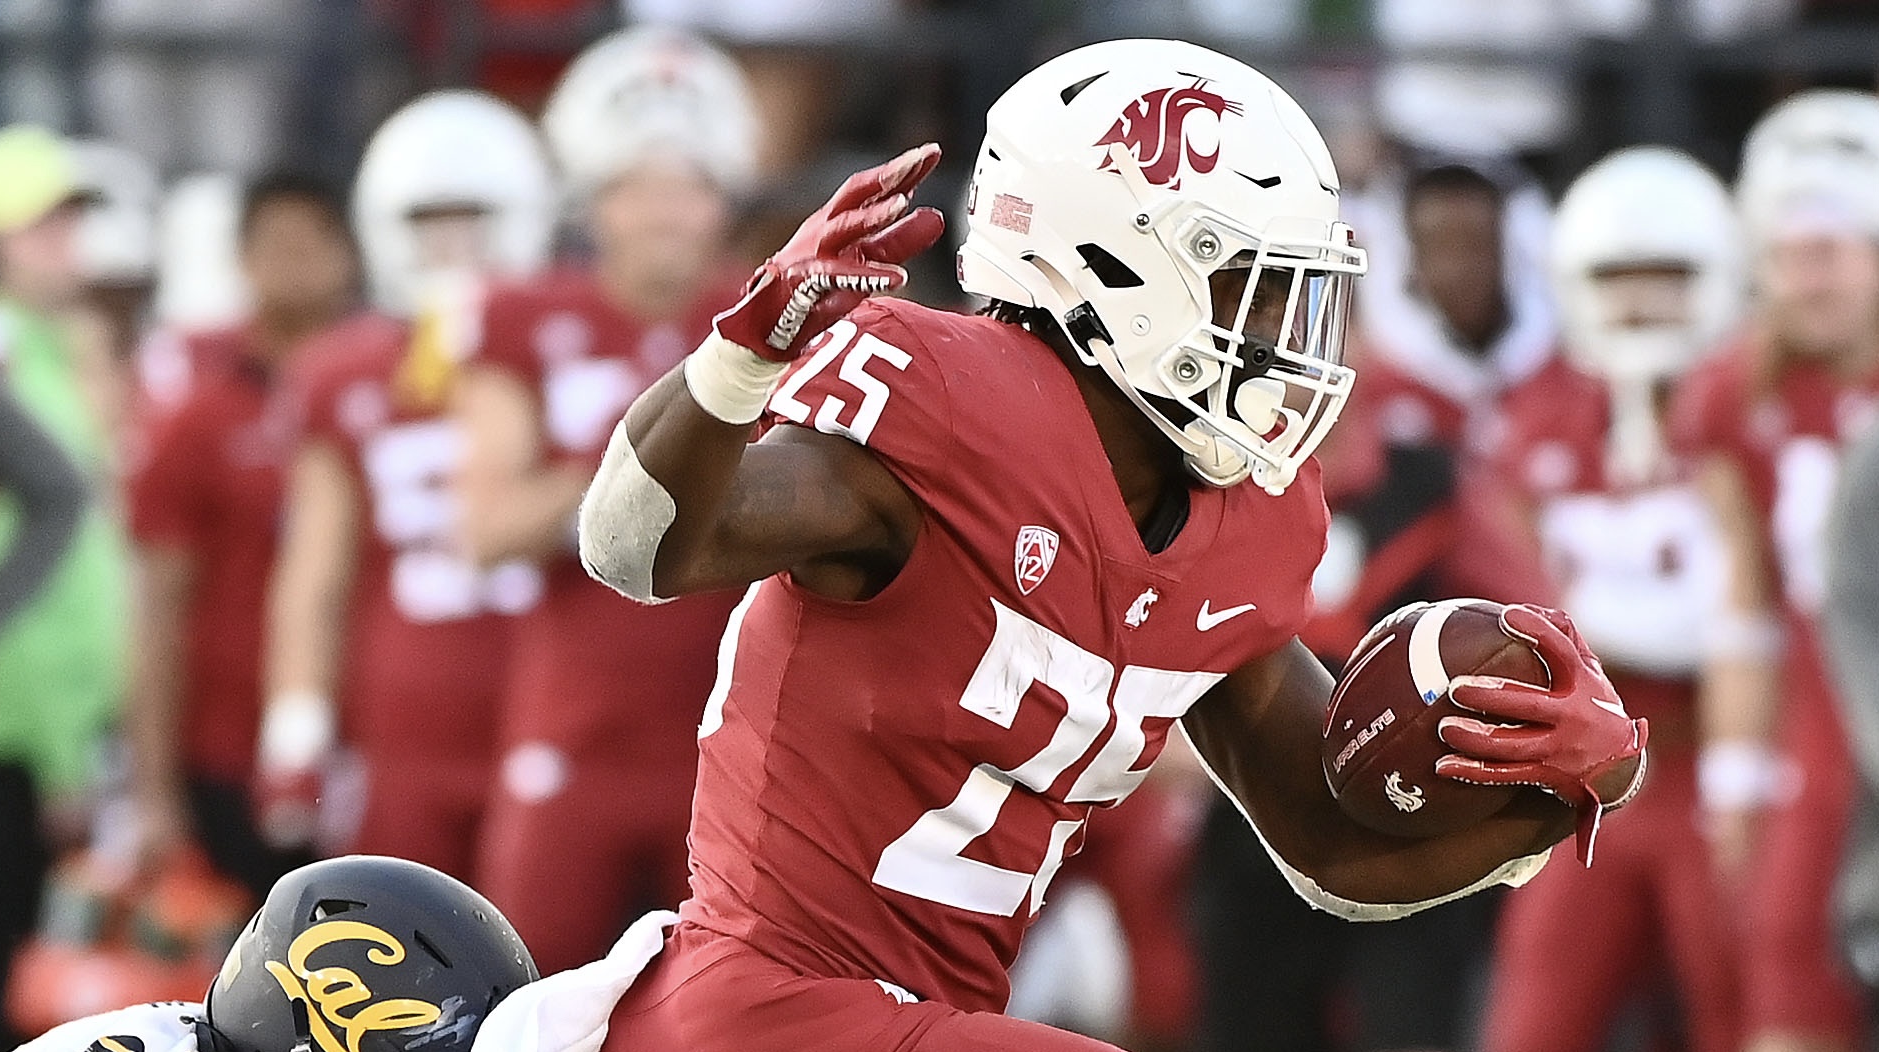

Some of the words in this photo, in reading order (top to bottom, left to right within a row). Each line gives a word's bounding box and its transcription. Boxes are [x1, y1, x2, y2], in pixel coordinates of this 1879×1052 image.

[768, 319, 914, 446] 25
[1018, 529, 1057, 571] PAC
[1020, 555, 1042, 582] 12
[1356, 708, 1396, 747] ELITE
[872, 597, 1228, 918] 25
